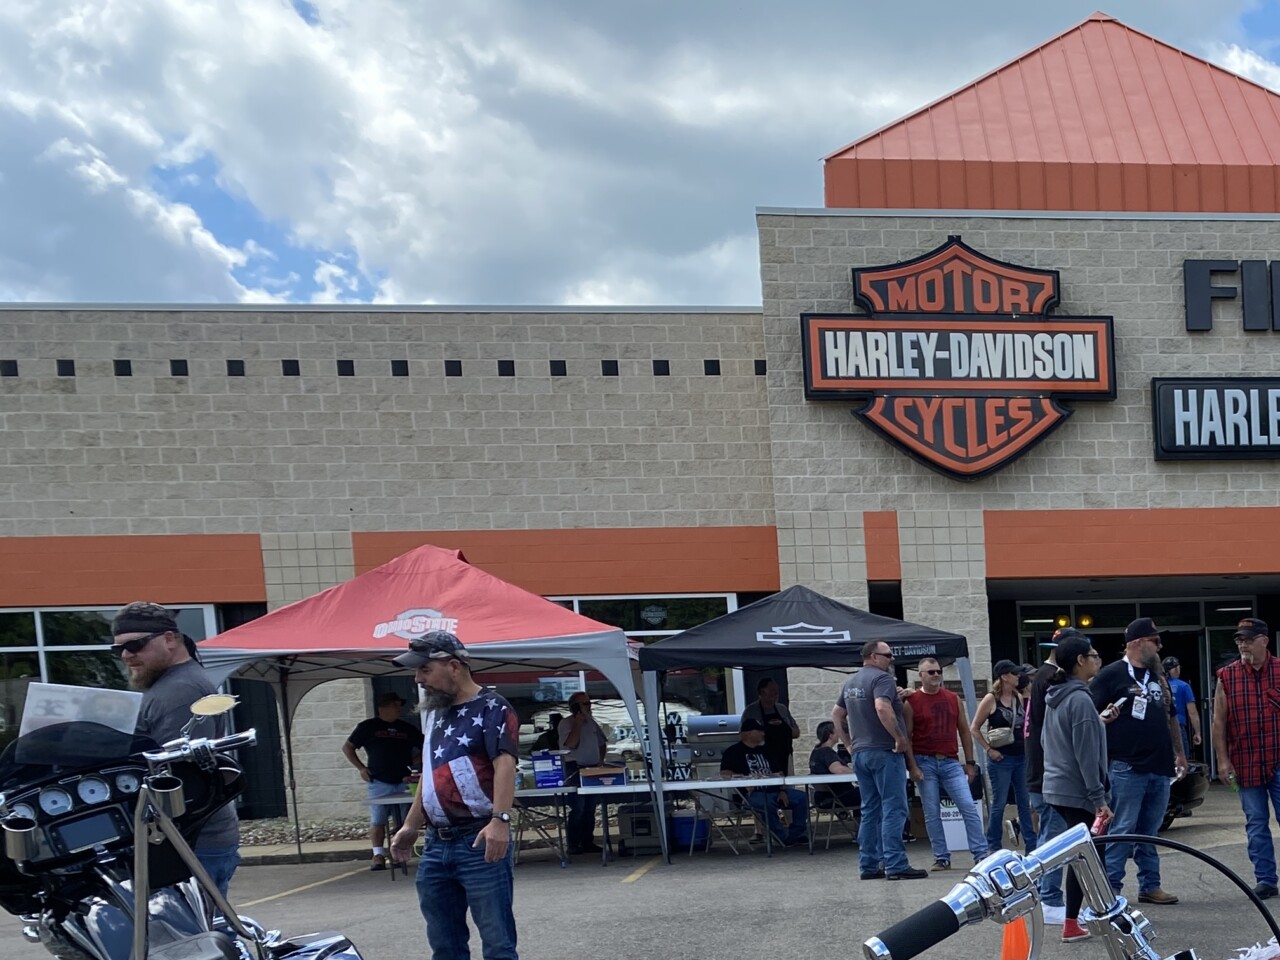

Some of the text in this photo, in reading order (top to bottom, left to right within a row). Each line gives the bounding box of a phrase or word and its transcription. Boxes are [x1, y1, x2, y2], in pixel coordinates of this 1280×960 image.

[887, 254, 1031, 313] MOTOR
[824, 330, 1096, 380] HARLEY-DAVIDSON
[893, 396, 1034, 459] CYCLES
